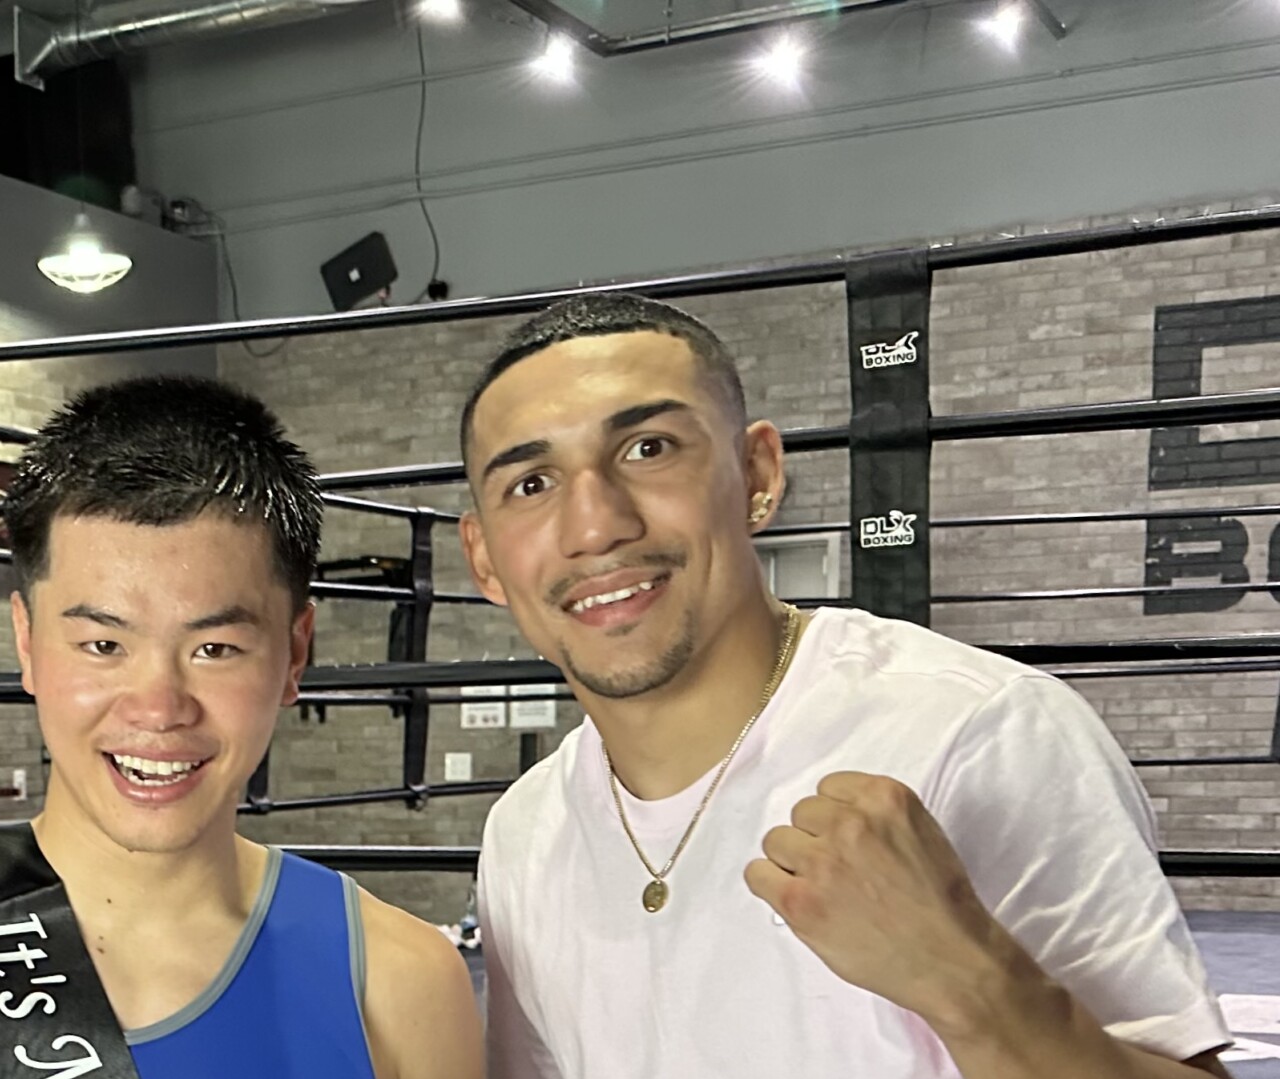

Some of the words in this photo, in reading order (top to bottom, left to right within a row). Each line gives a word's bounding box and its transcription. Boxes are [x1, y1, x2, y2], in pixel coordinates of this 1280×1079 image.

[864, 352, 915, 368] BOXING
[861, 510, 917, 536] DLX
[863, 534, 913, 547] BOXING
